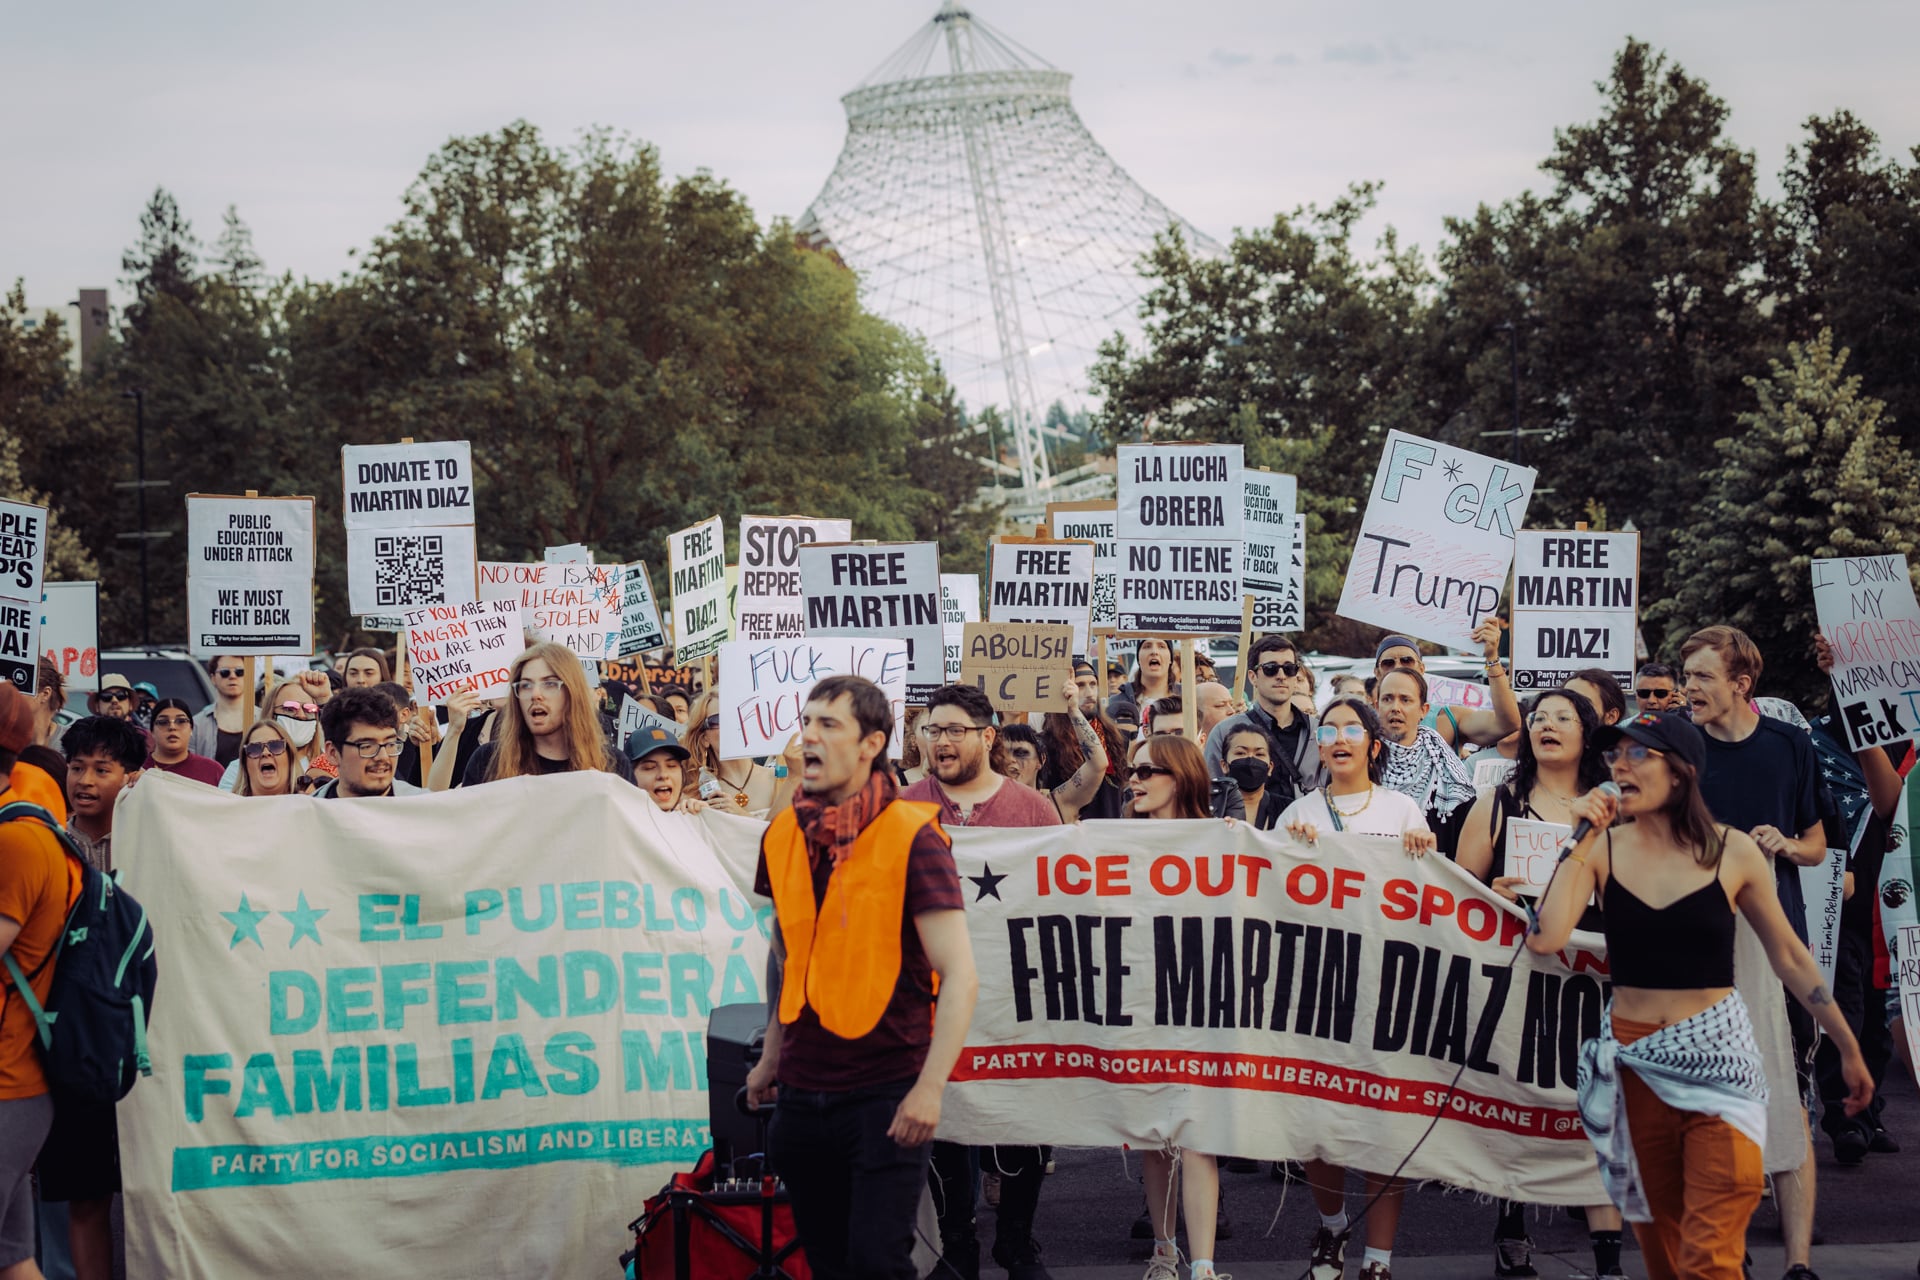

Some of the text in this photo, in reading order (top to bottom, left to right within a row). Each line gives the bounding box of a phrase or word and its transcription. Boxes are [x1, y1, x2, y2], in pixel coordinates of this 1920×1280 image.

[358, 458, 458, 485] DONATE TO
[1169, 456, 1228, 482] LUCHA
[350, 486, 471, 513] MARTIN DIAZ
[1244, 482, 1271, 498] PUBLIC
[229, 514, 272, 529] PUBLIC
[1139, 495, 1225, 527] OBRERA
[1253, 509, 1284, 526] ATTACK
[0, 512, 37, 539] PLE
[217, 530, 283, 546] EDUCATION
[1063, 523, 1114, 539] DONATE
[204, 546, 293, 562] UNDER ATTACK
[683, 526, 713, 561] FREE
[1248, 542, 1275, 559] MUST
[1542, 538, 1609, 569] FREE
[831, 552, 908, 587] FREE
[1015, 550, 1071, 575] FREE
[1129, 546, 1162, 573] NO
[1169, 546, 1233, 574] TIENE
[1253, 558, 1279, 576] BACK
[1812, 556, 1901, 589] I DRINK
[481, 565, 580, 585] NO ONE IS
[674, 553, 724, 597] MARTIN
[743, 571, 803, 597] REPRE
[1363, 532, 1500, 630] Trump
[218, 589, 283, 607] WE MUST
[521, 587, 593, 609] ILLEGAL
[994, 581, 1089, 607] MARTIN
[1123, 578, 1237, 602] FRONTERAS!
[1517, 575, 1632, 608] MARTIN
[211, 608, 291, 626] FIGHT BACK
[404, 610, 426, 626] IF
[428, 605, 458, 621] YOU
[461, 601, 485, 617] ARE
[493, 599, 517, 613] NOT
[631, 611, 645, 624] NO
[685, 597, 718, 636] DIAZ!
[807, 592, 939, 630] MARTIN
[1851, 588, 1884, 620] MY
[411, 620, 469, 646] ANGRY
[470, 616, 507, 633] THEN
[533, 609, 600, 630] STOLEN
[741, 613, 773, 632] FREE
[1141, 615, 1158, 624] Party
[1199, 617, 1211, 625] and
[1212, 618, 1242, 626] Liberation
[0, 629, 29, 659] A!
[409, 634, 506, 665] YOU ARE NOT
[971, 633, 1068, 661] ABOLISH
[1537, 627, 1611, 660] DIAZ!
[412, 659, 472, 685] PAYING
[750, 644, 836, 692] FUCK
[850, 646, 907, 685] ICE
[1537, 671, 1557, 680] Party
[1557, 671, 1569, 679] for
[1831, 664, 1892, 698] WARM
[977, 673, 1051, 700] ICE
[1537, 679, 1551, 688] and
[1511, 824, 1570, 853] FUCK
[1036, 854, 1132, 897] ICE
[1150, 854, 1272, 897] OUT
[1286, 864, 1366, 910] OF
[358, 893, 443, 942] EL
[464, 880, 708, 936] PUEBLO
[269, 936, 761, 1036] DEFENDERÁ
[1007, 914, 1612, 1091] FREE MARTIN DIAZ NO
[183, 1031, 601, 1124] FAMILIAS
[972, 1051, 1047, 1071] PARTY
[1055, 1051, 1095, 1068] FOR
[1100, 1057, 1218, 1077] SOCIALISM
[1222, 1062, 1257, 1078] AND
[1262, 1063, 1400, 1102] LIBERATION
[1424, 1089, 1532, 1128] SPOKANE
[210, 1152, 300, 1176] PARTY
[309, 1148, 360, 1170] FOR
[371, 1134, 527, 1167] SOCIALISM
[537, 1128, 594, 1151] AND
